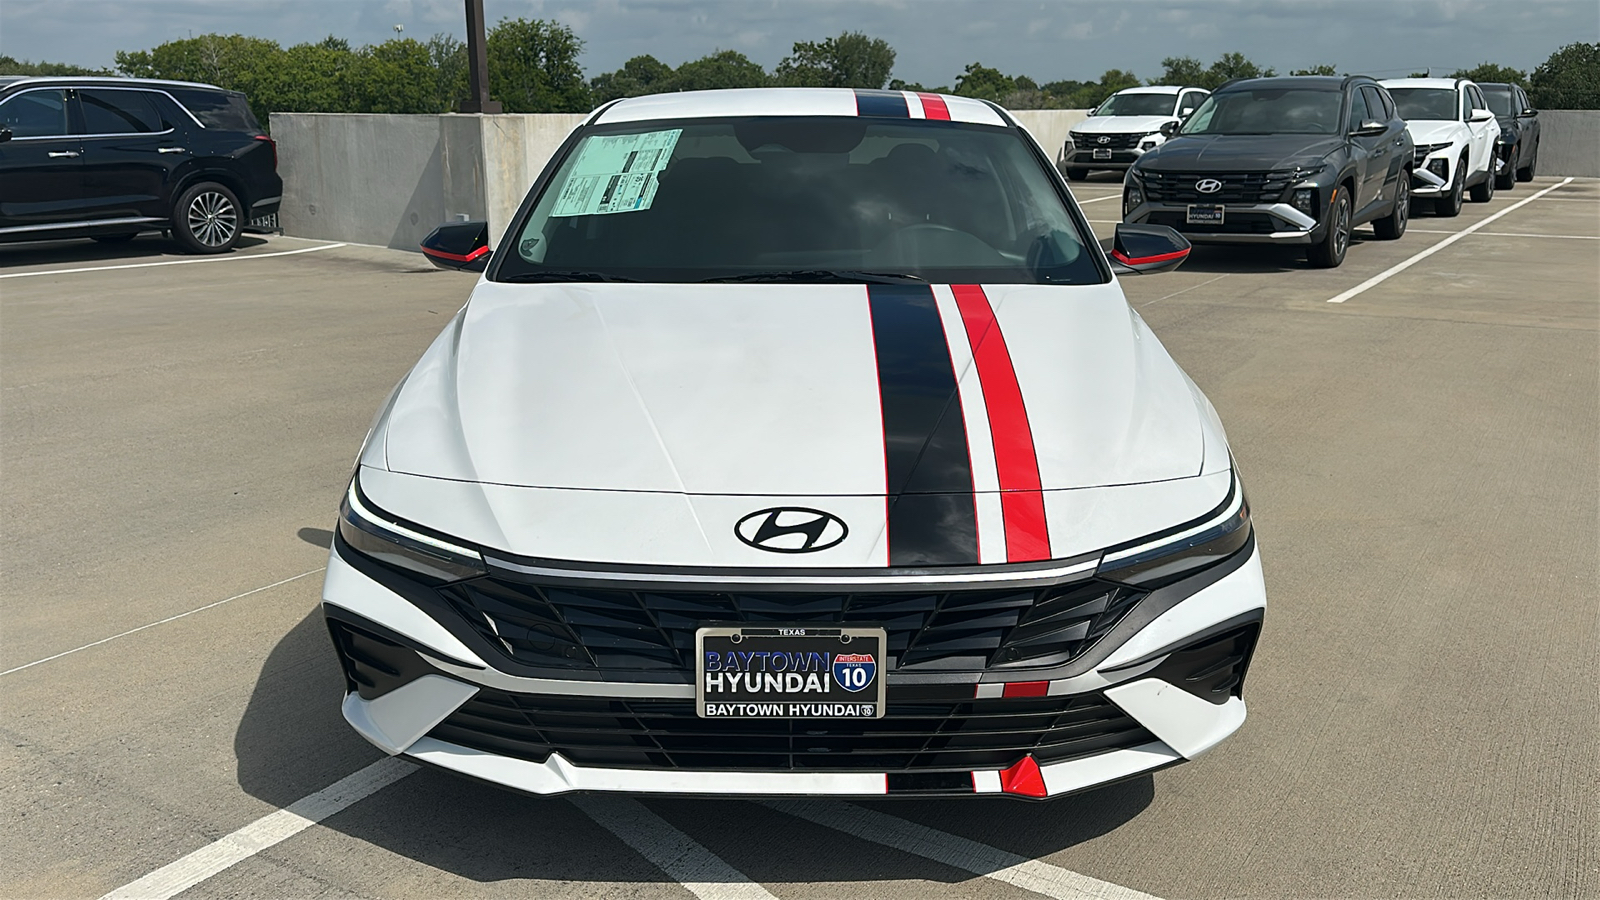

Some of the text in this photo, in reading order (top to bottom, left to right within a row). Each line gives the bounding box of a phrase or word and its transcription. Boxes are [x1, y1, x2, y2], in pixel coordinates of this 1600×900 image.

[706, 651, 830, 672] BAYTOWN
[706, 672, 830, 693] HYUNDAI
[842, 667, 867, 687] 10
[706, 704, 860, 716] BAYTOWN HYUNDAI
